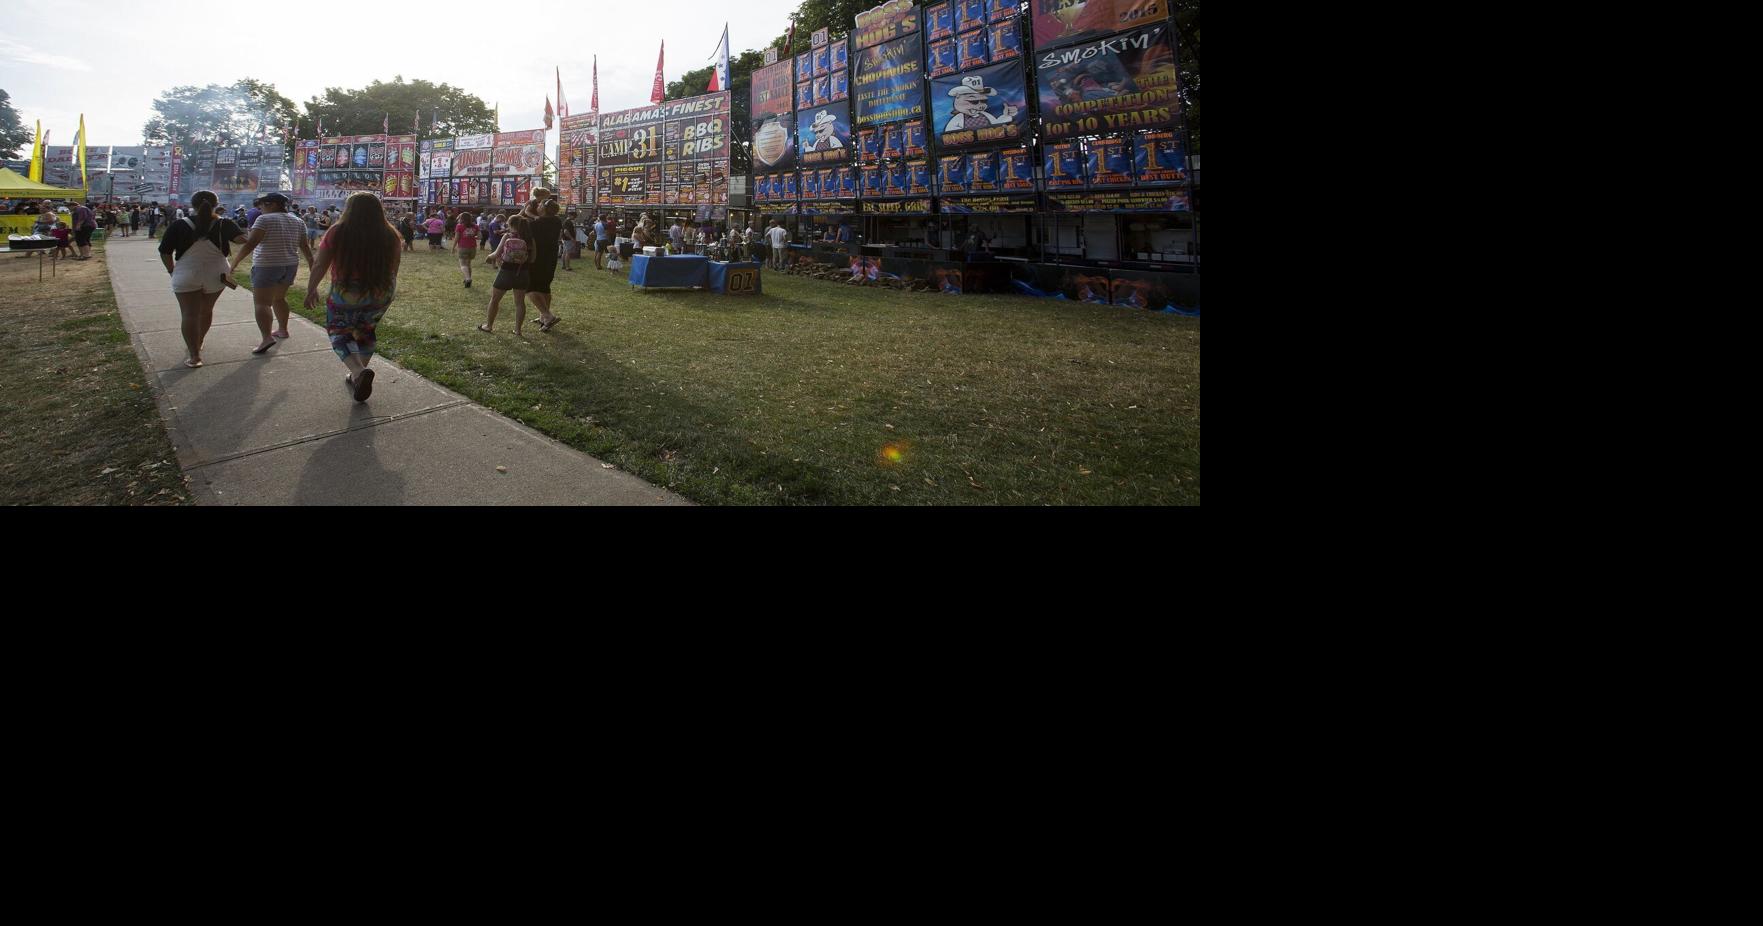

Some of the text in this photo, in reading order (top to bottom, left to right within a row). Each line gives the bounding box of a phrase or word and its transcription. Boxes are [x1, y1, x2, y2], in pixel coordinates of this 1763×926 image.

[813, 31, 826, 45] 01
[765, 51, 776, 63] 01
[603, 106, 669, 126] ALABAMA'S
[671, 96, 724, 116] FINEST
[1056, 88, 1168, 115] COMPETITION
[684, 118, 723, 141] BBQ
[1046, 107, 1170, 136] for 10 YEARS
[601, 138, 633, 159] CAMP
[632, 126, 658, 159] 31
[682, 136, 724, 156] RIBS
[613, 176, 629, 193] #1
[729, 272, 754, 292] 01
